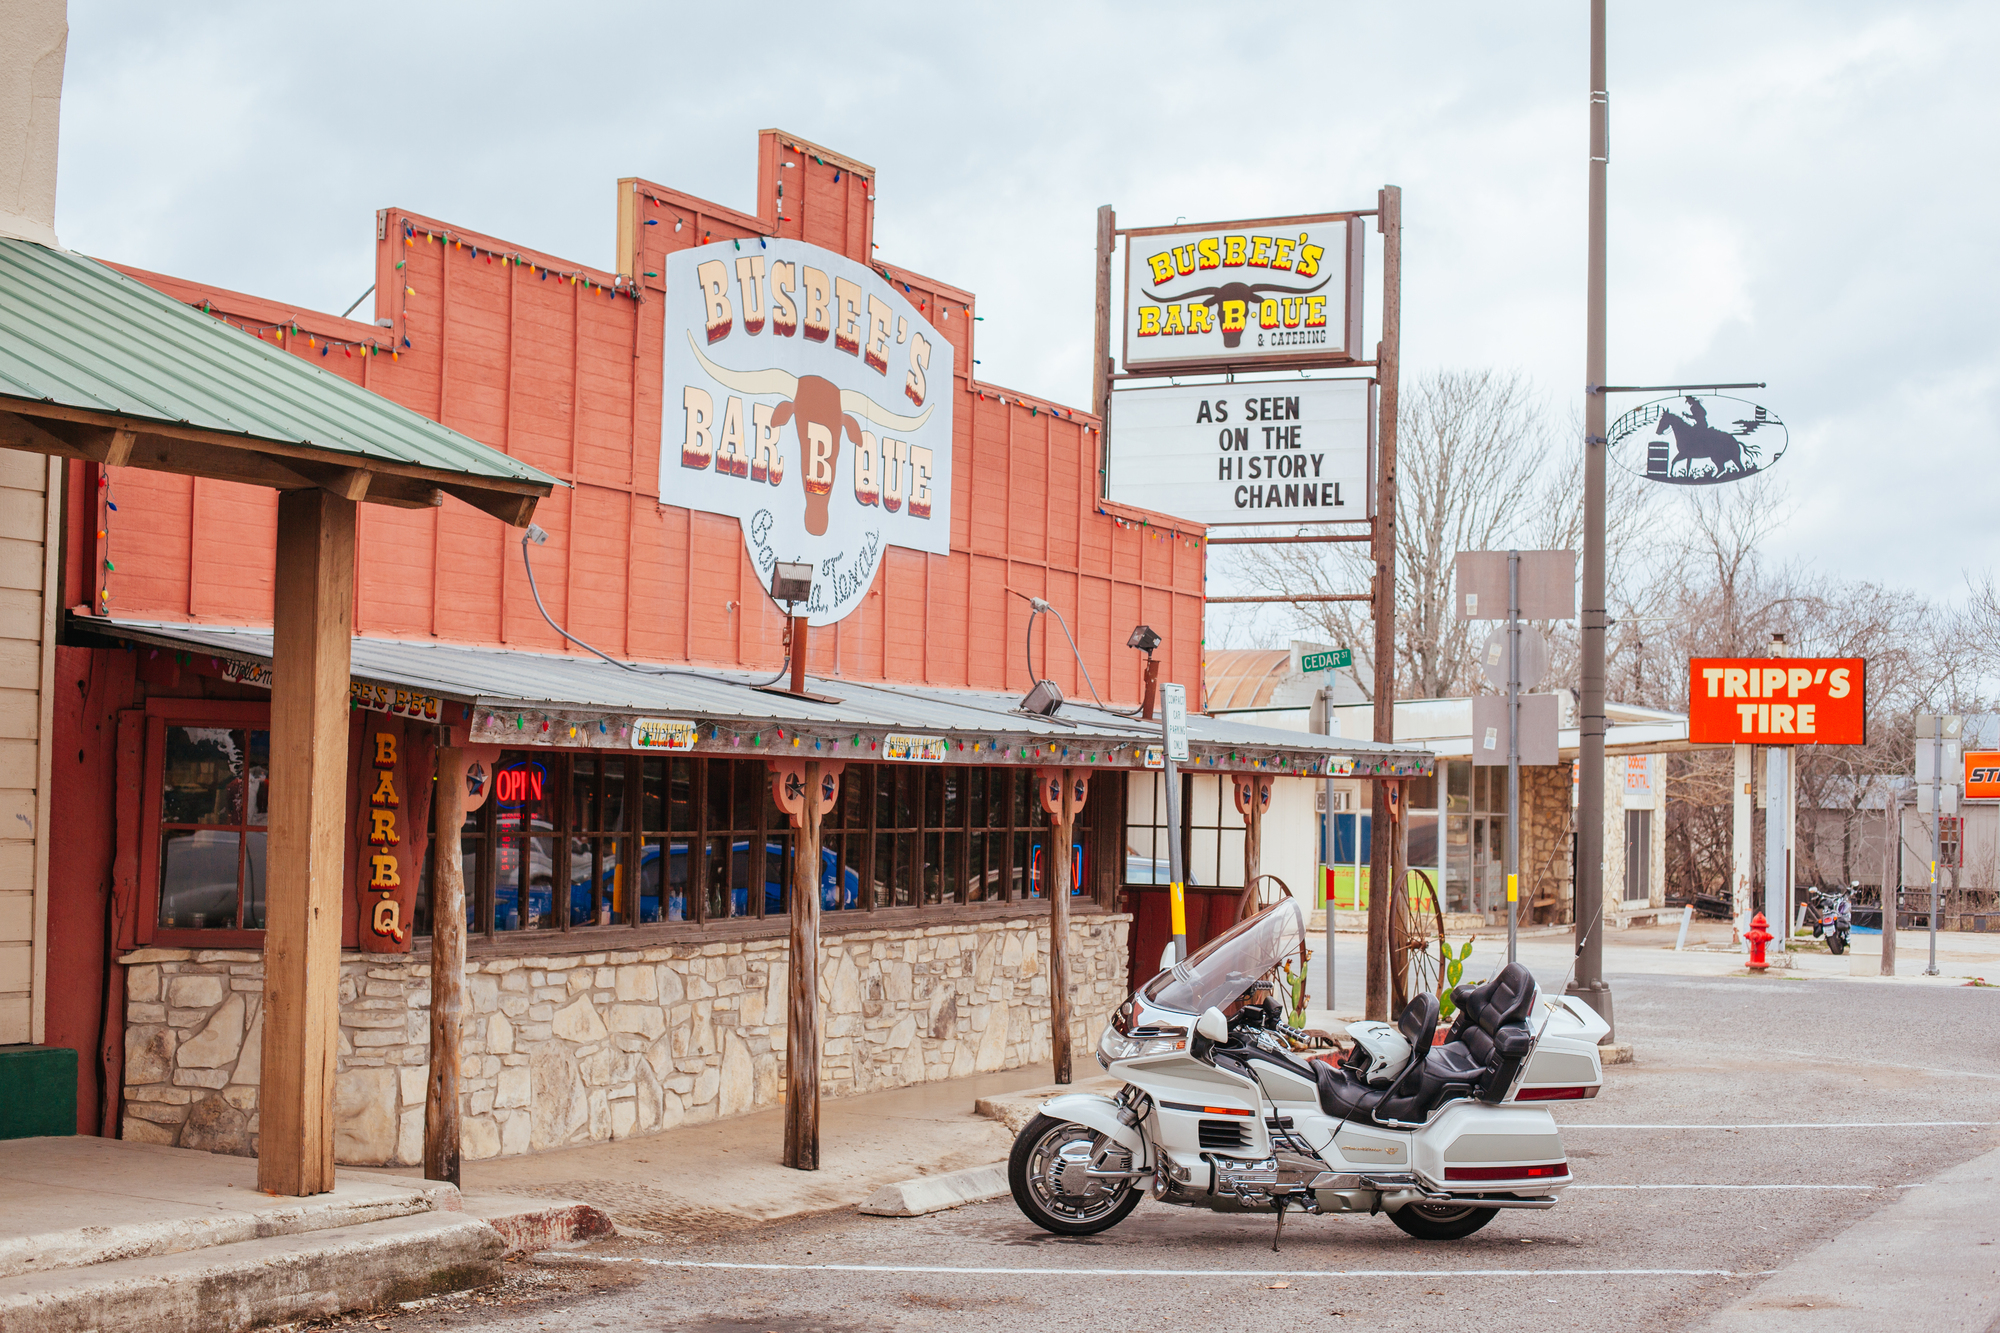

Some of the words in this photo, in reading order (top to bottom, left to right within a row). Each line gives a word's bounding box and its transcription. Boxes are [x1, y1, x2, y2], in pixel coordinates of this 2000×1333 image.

[1147, 233, 1324, 286] BUSBEE'S
[697, 255, 931, 407] BUSBEE'S
[1258, 333, 1265, 347] &
[1271, 329, 1326, 346] CATERING
[1196, 400, 1228, 423] AS
[1245, 396, 1300, 421] SEEN
[1219, 427, 1248, 451] ON
[1262, 425, 1302, 450] THE
[681, 385, 784, 486] BAR
[805, 421, 833, 496] B
[854, 431, 933, 519] QUE
[1218, 453, 1325, 480] HISTORY
[1234, 482, 1345, 509] CHANNEL
[1304, 652, 1341, 669] CEDAR
[1341, 651, 1348, 659] ST
[1702, 667, 1851, 699] TRIPP'S
[1168, 694, 1185, 706] COMPACT
[1172, 709, 1181, 720] CAR
[1736, 703, 1816, 734] TIRE
[638, 721, 692, 748] CHICKEN
[1169, 724, 1186, 736] PARKING
[1173, 739, 1184, 750] ONLY
[1627, 773, 1650, 789] RENTAL
[1969, 767, 2000, 783] ST
